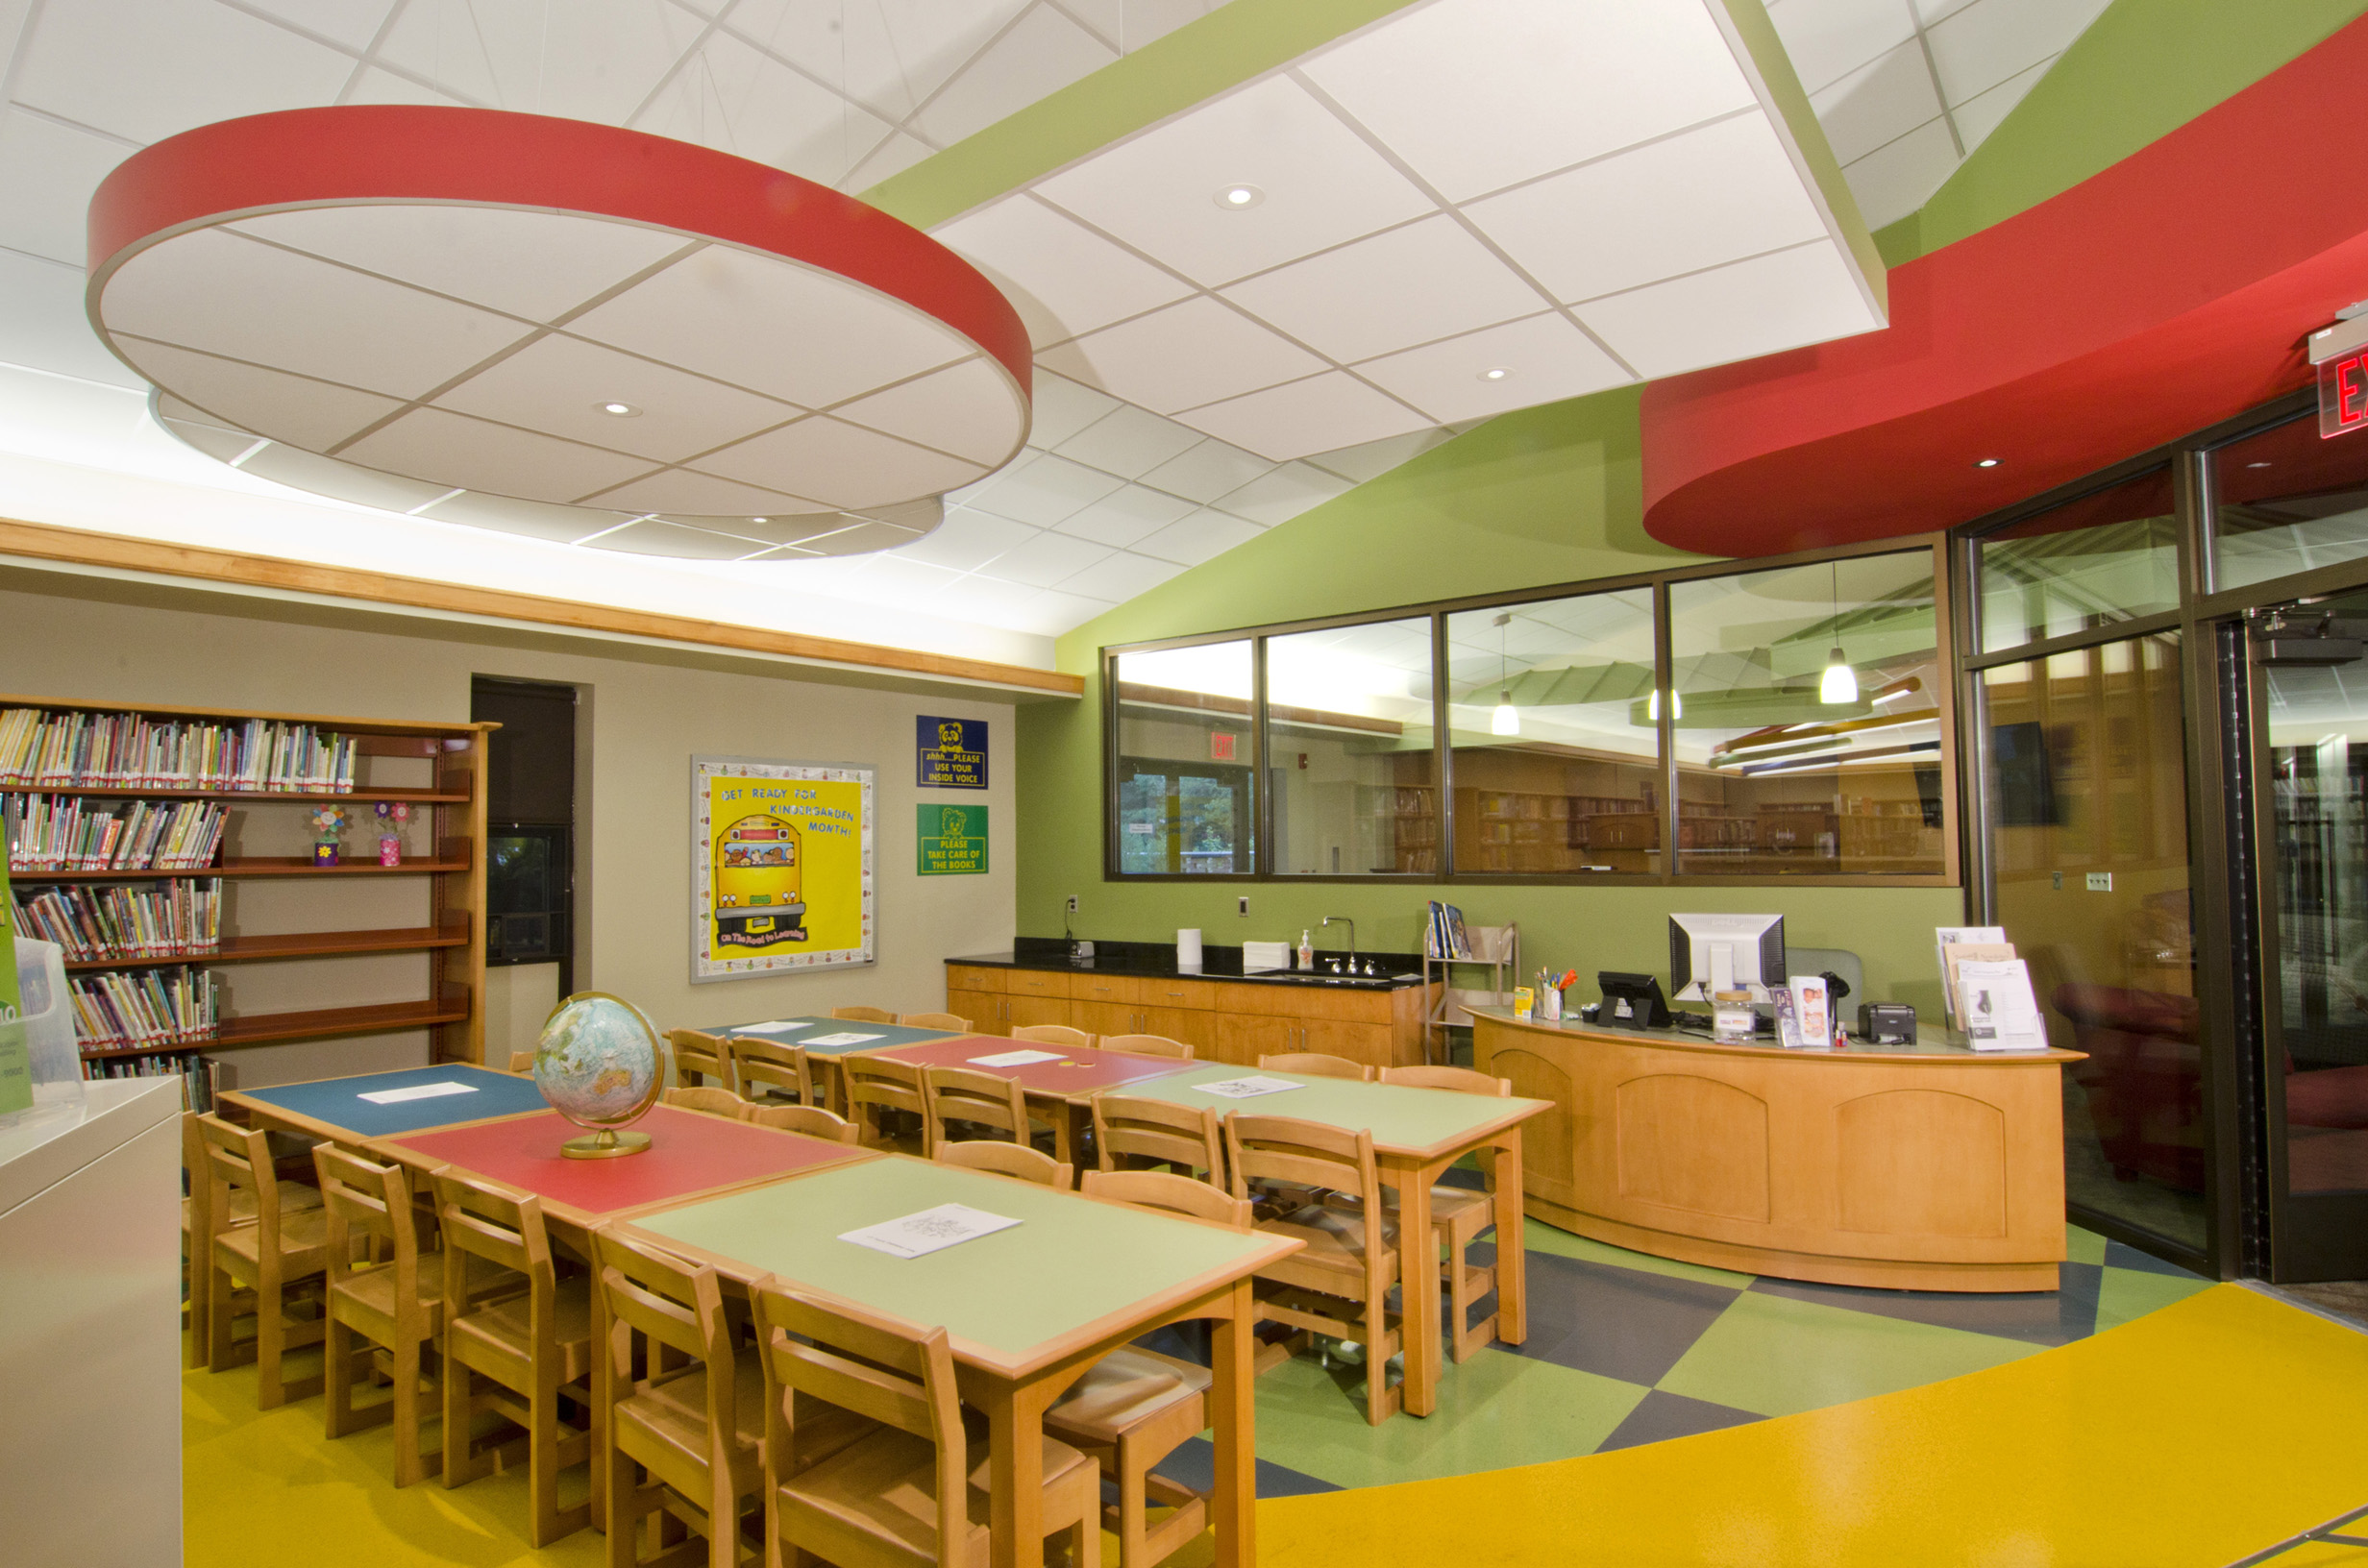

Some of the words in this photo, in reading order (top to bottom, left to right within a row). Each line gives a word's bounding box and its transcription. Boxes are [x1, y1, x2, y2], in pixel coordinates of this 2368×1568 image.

[951, 764, 973, 772] YOUR
[928, 773, 953, 782] INSIDE
[956, 774, 977, 783] VOICE
[722, 789, 743, 801] GET
[752, 788, 787, 799] READY
[795, 789, 817, 800] FOR
[770, 804, 854, 822] KINDERGARDEN
[808, 821, 851, 839] MONTH!
[940, 840, 968, 849] PLEASE
[927, 850, 947, 859] TAKE
[949, 850, 968, 859] CARE
[970, 849, 980, 858] OF
[932, 861, 947, 870] THE
[950, 861, 975, 870] BOOKS
[732, 933, 746, 943] The
[746, 935, 765, 944] Road
[765, 933, 774, 942] to
[774, 929, 805, 940] Learning
